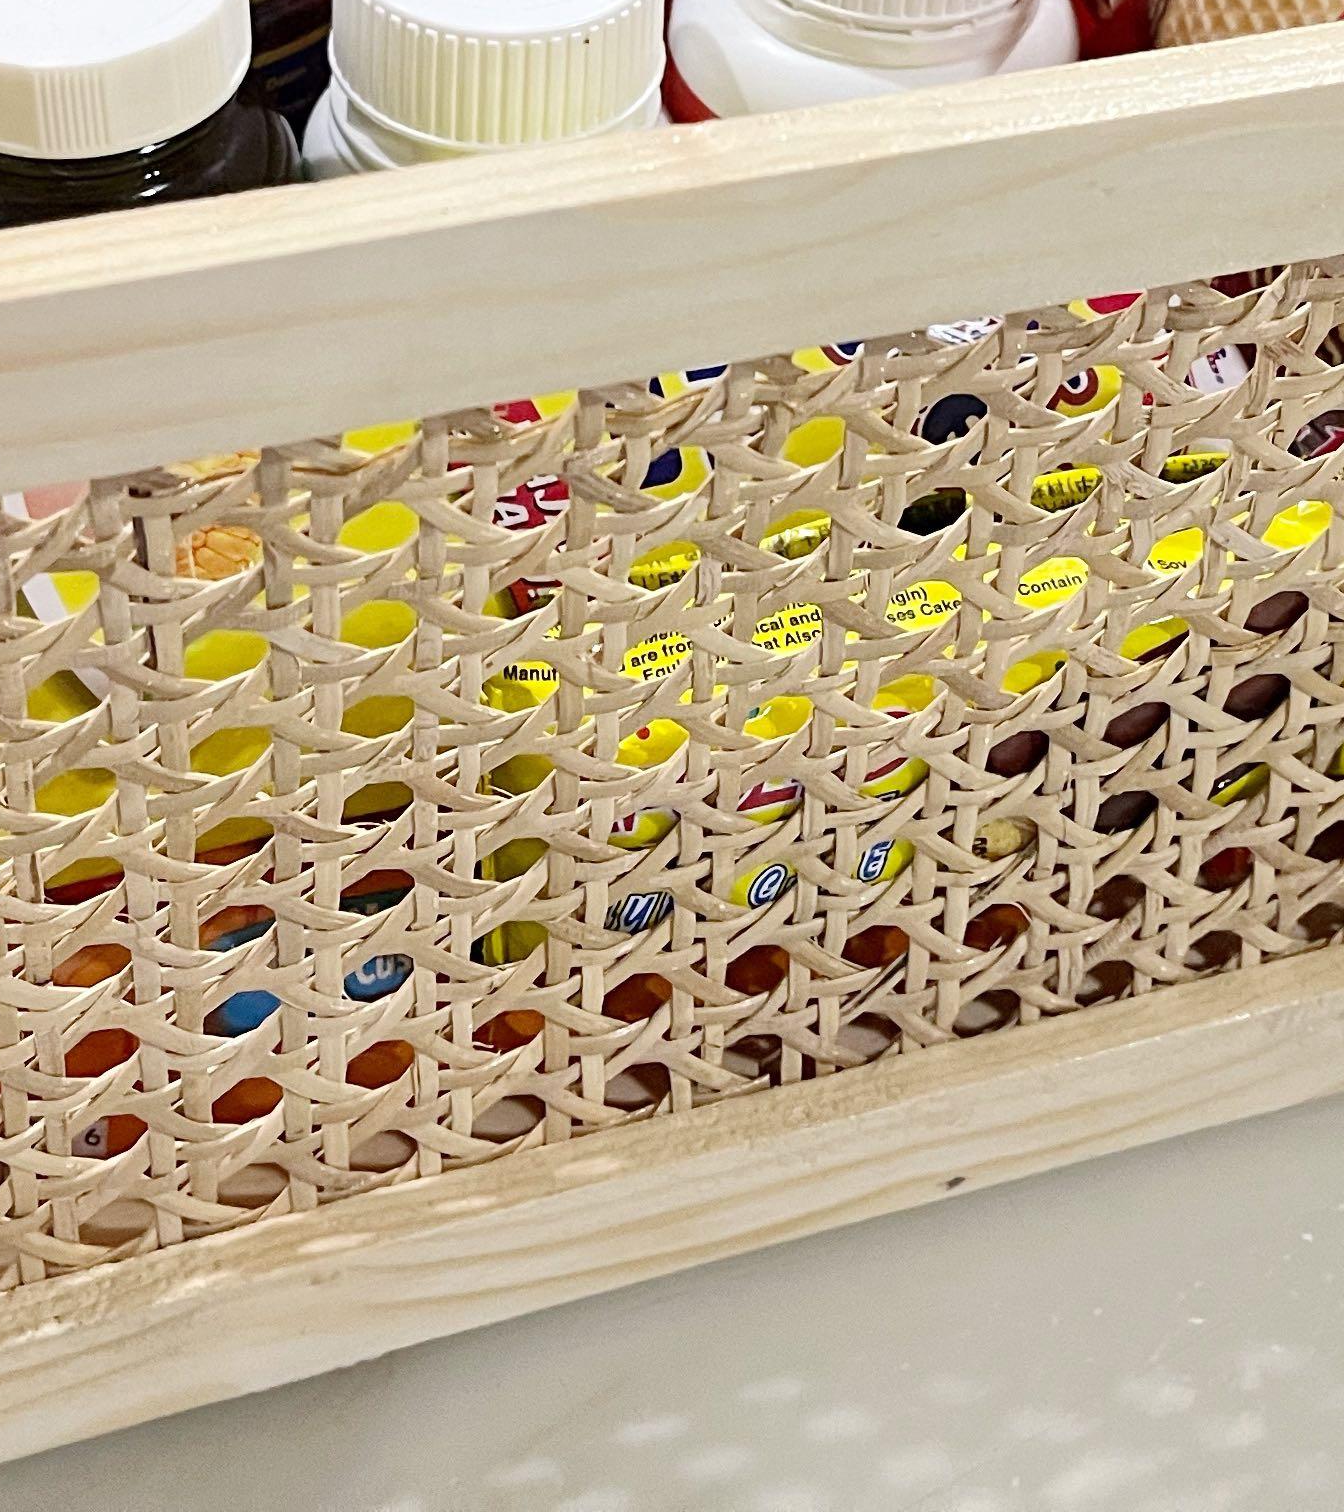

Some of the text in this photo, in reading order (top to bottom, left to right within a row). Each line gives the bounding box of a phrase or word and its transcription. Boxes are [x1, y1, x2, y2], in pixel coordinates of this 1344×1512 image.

[1018, 572, 1084, 597] Contain
[789, 609, 821, 626] and
[630, 650, 658, 668] are
